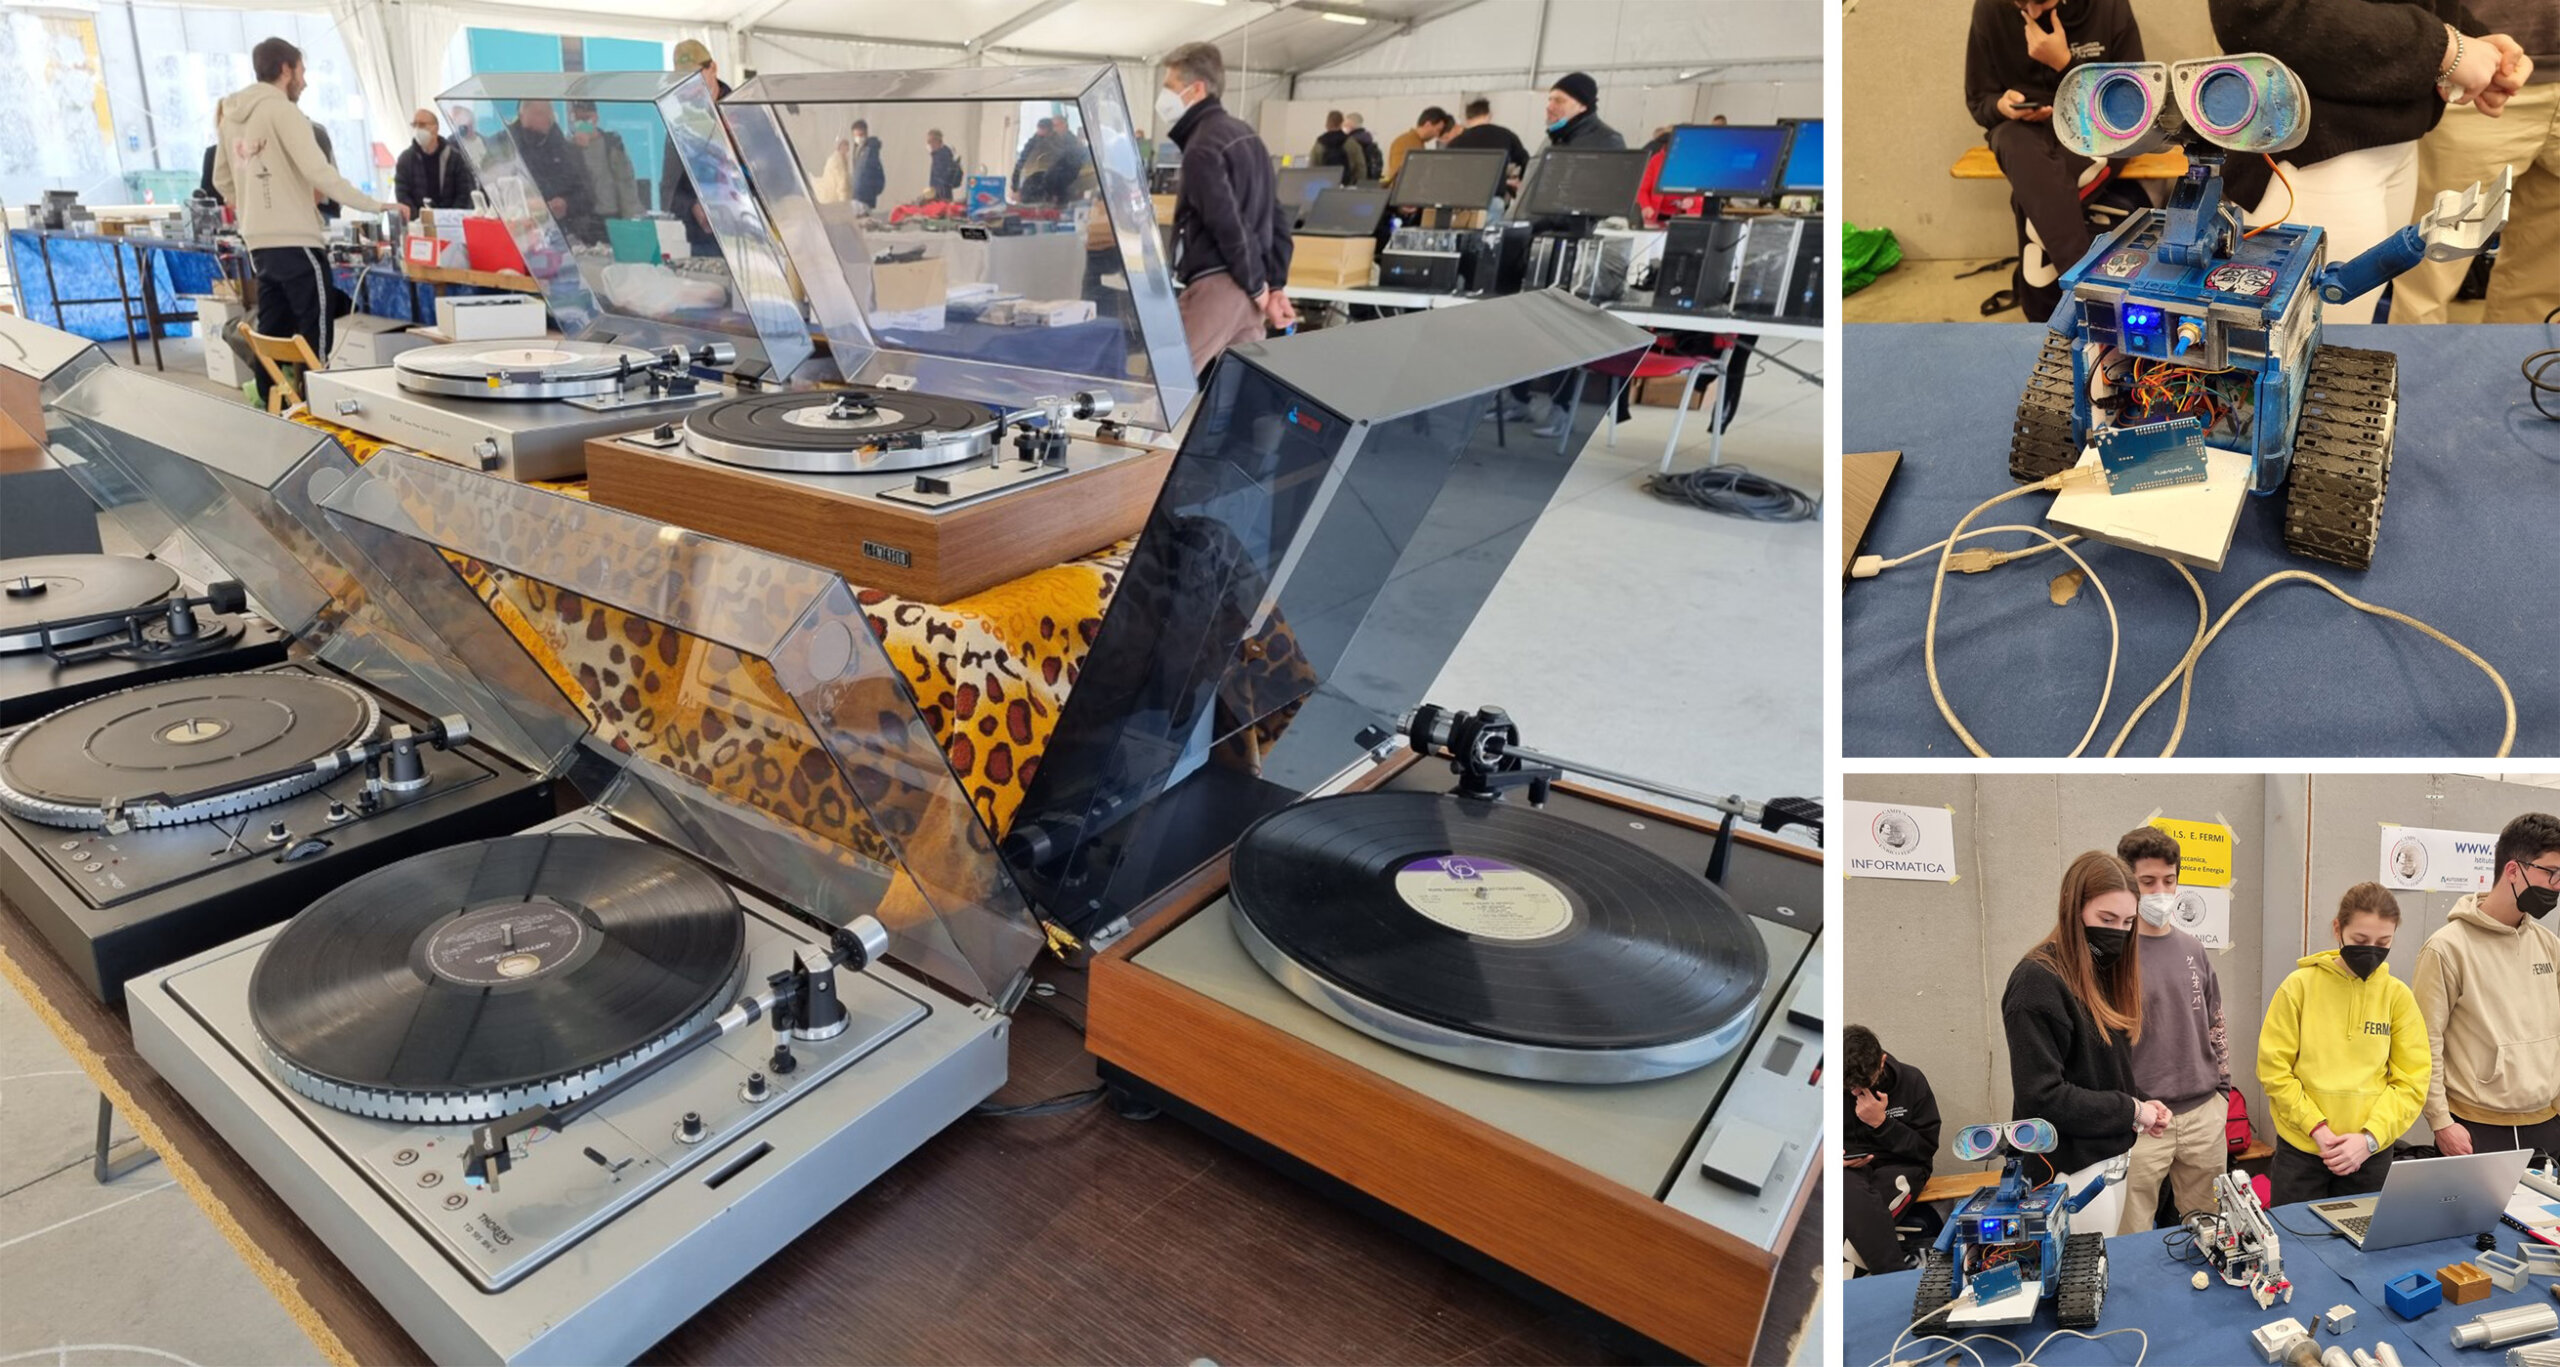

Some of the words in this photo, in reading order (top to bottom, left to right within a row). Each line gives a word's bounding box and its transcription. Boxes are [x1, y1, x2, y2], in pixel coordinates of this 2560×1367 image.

[2190, 832, 2198, 840] E.
[2199, 833, 2224, 843] FERMI
[2180, 855, 2208, 864] eccanica,
[1851, 858, 1946, 874] INFORMATICA
[2202, 866, 2225, 875] Energia
[2195, 933, 2219, 944] NICA
[2364, 1021, 2390, 1036] FERM
[478, 1212, 515, 1245] THORENS
